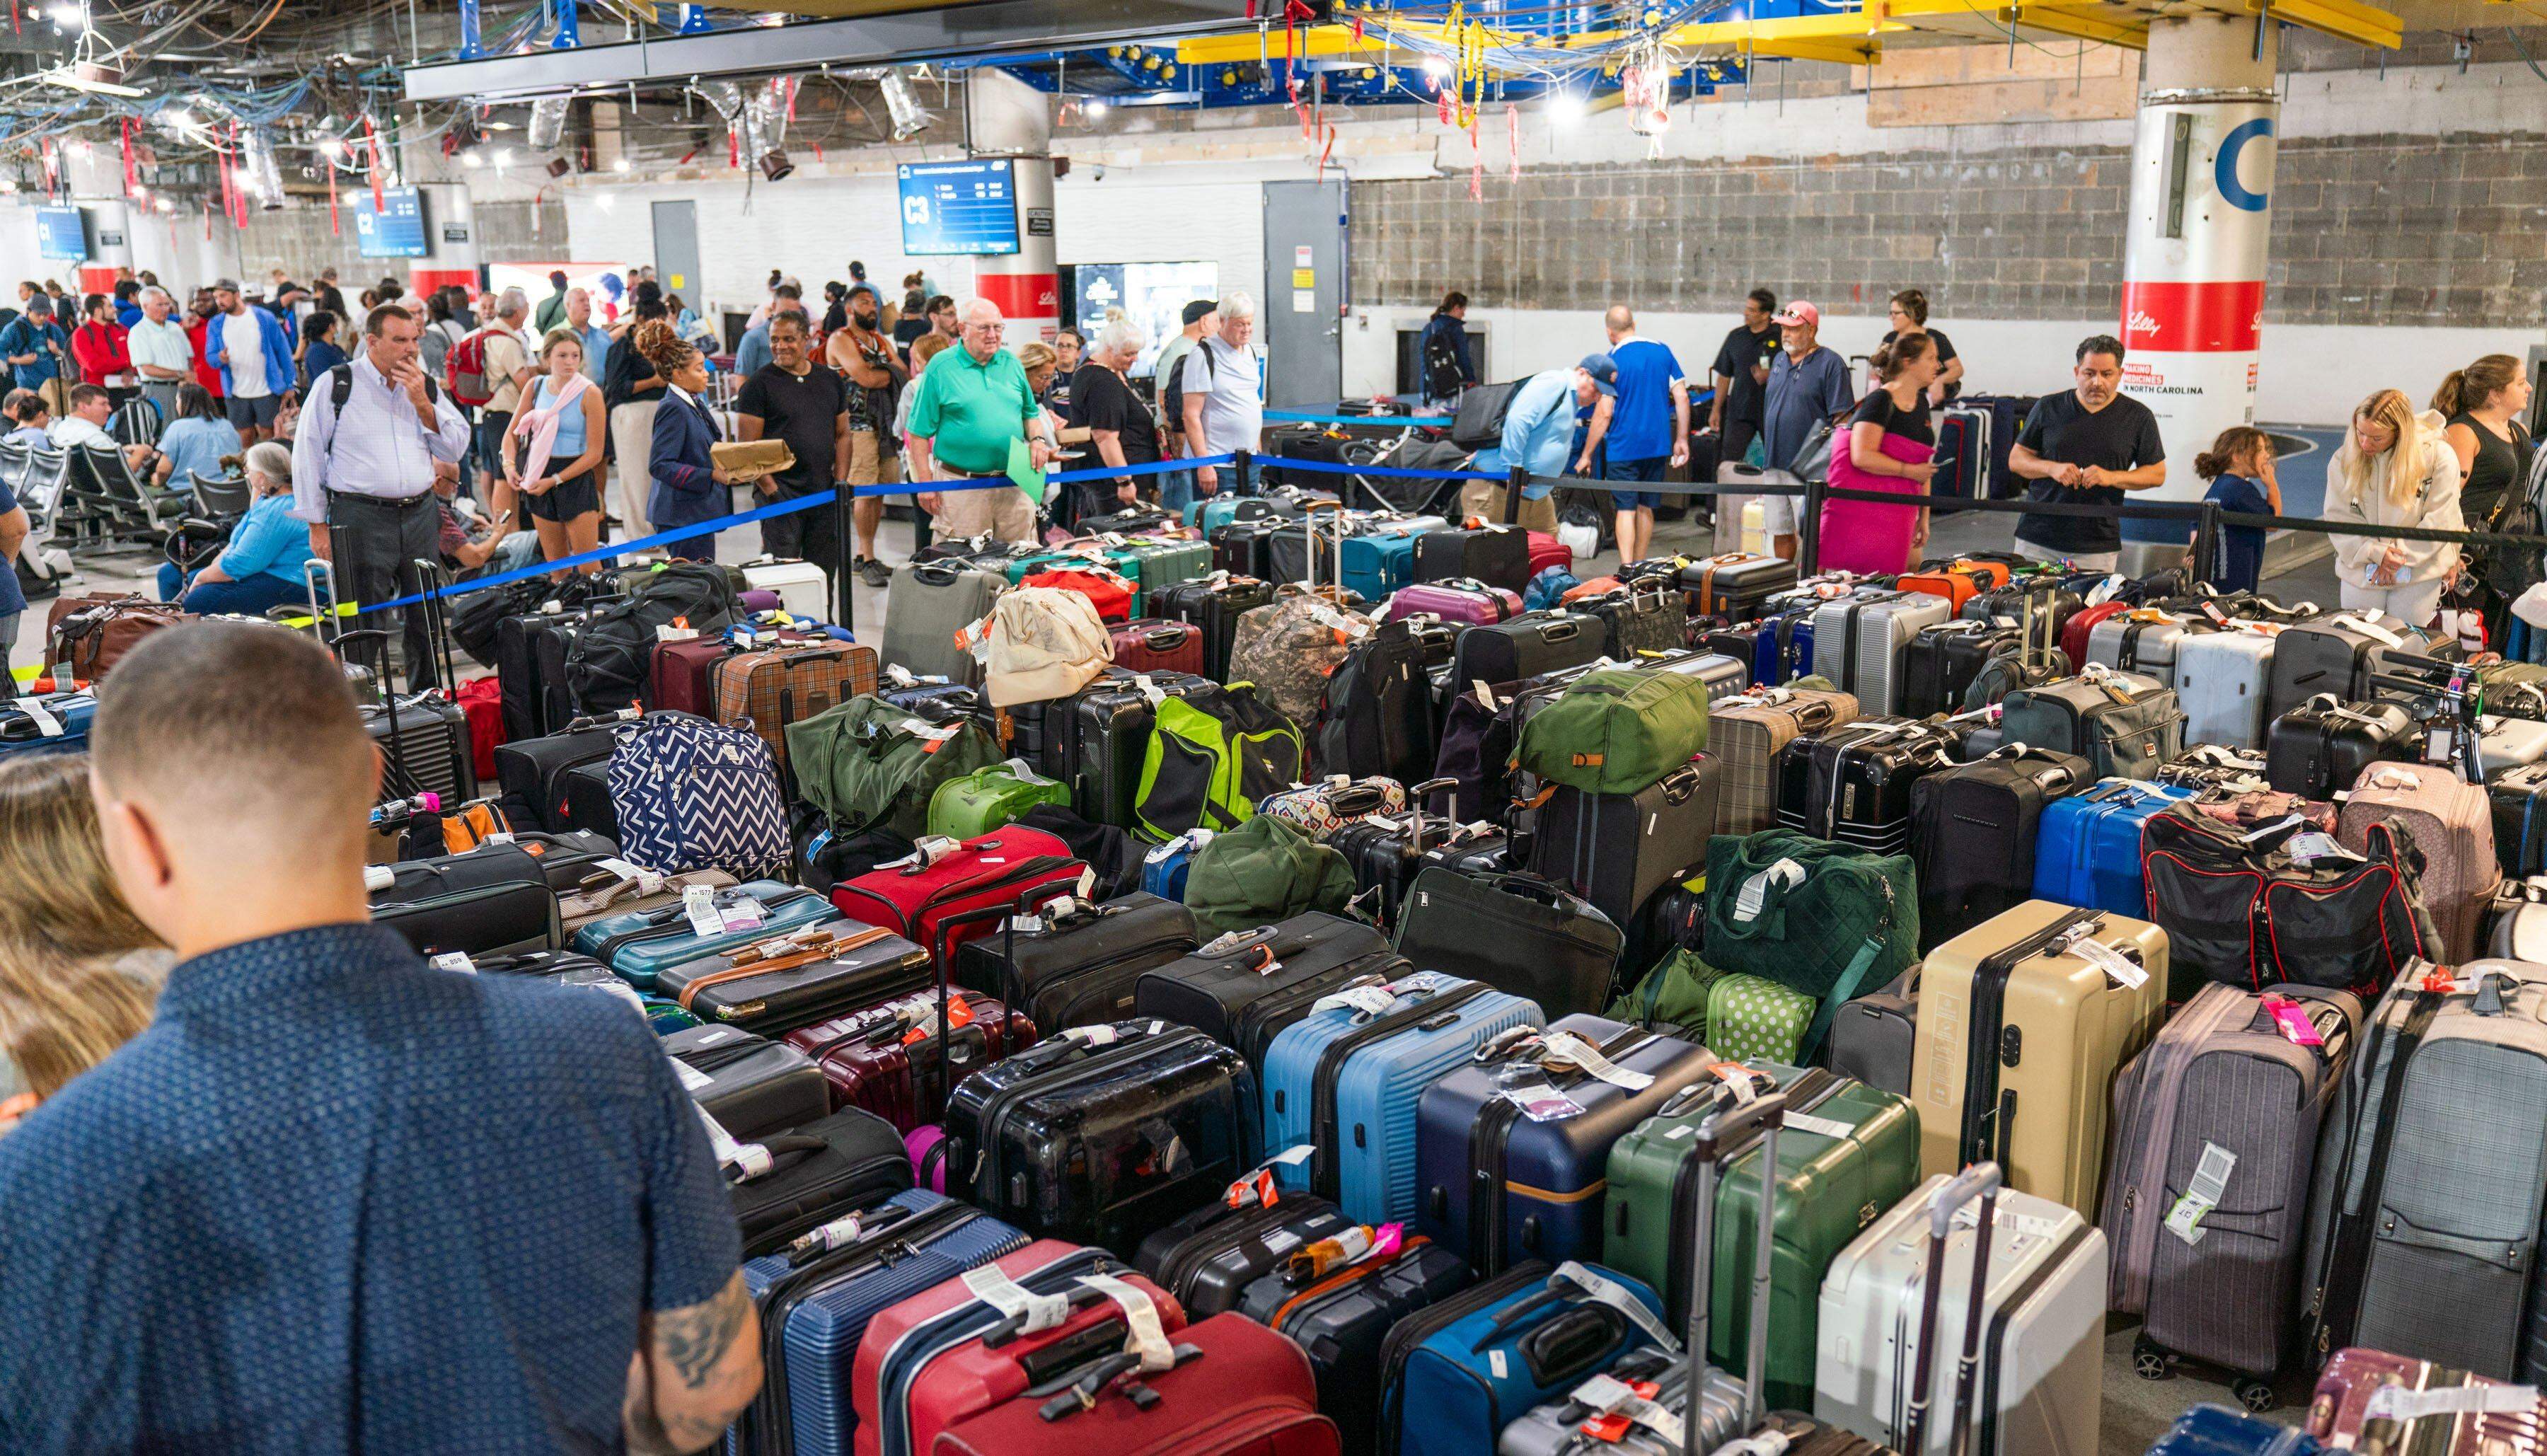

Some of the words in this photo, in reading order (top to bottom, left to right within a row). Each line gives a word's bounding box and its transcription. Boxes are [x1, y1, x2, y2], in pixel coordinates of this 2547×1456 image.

[2215, 118, 2275, 212] C
[904, 196, 930, 224] C3
[357, 213, 374, 235] C2
[2125, 310, 2161, 337] Lilly
[2124, 364, 2151, 374] MAKING
[2124, 374, 2163, 383] MEDICINES
[2130, 385, 2154, 393] NORTH
[2156, 386, 2203, 395] CAROLINA
